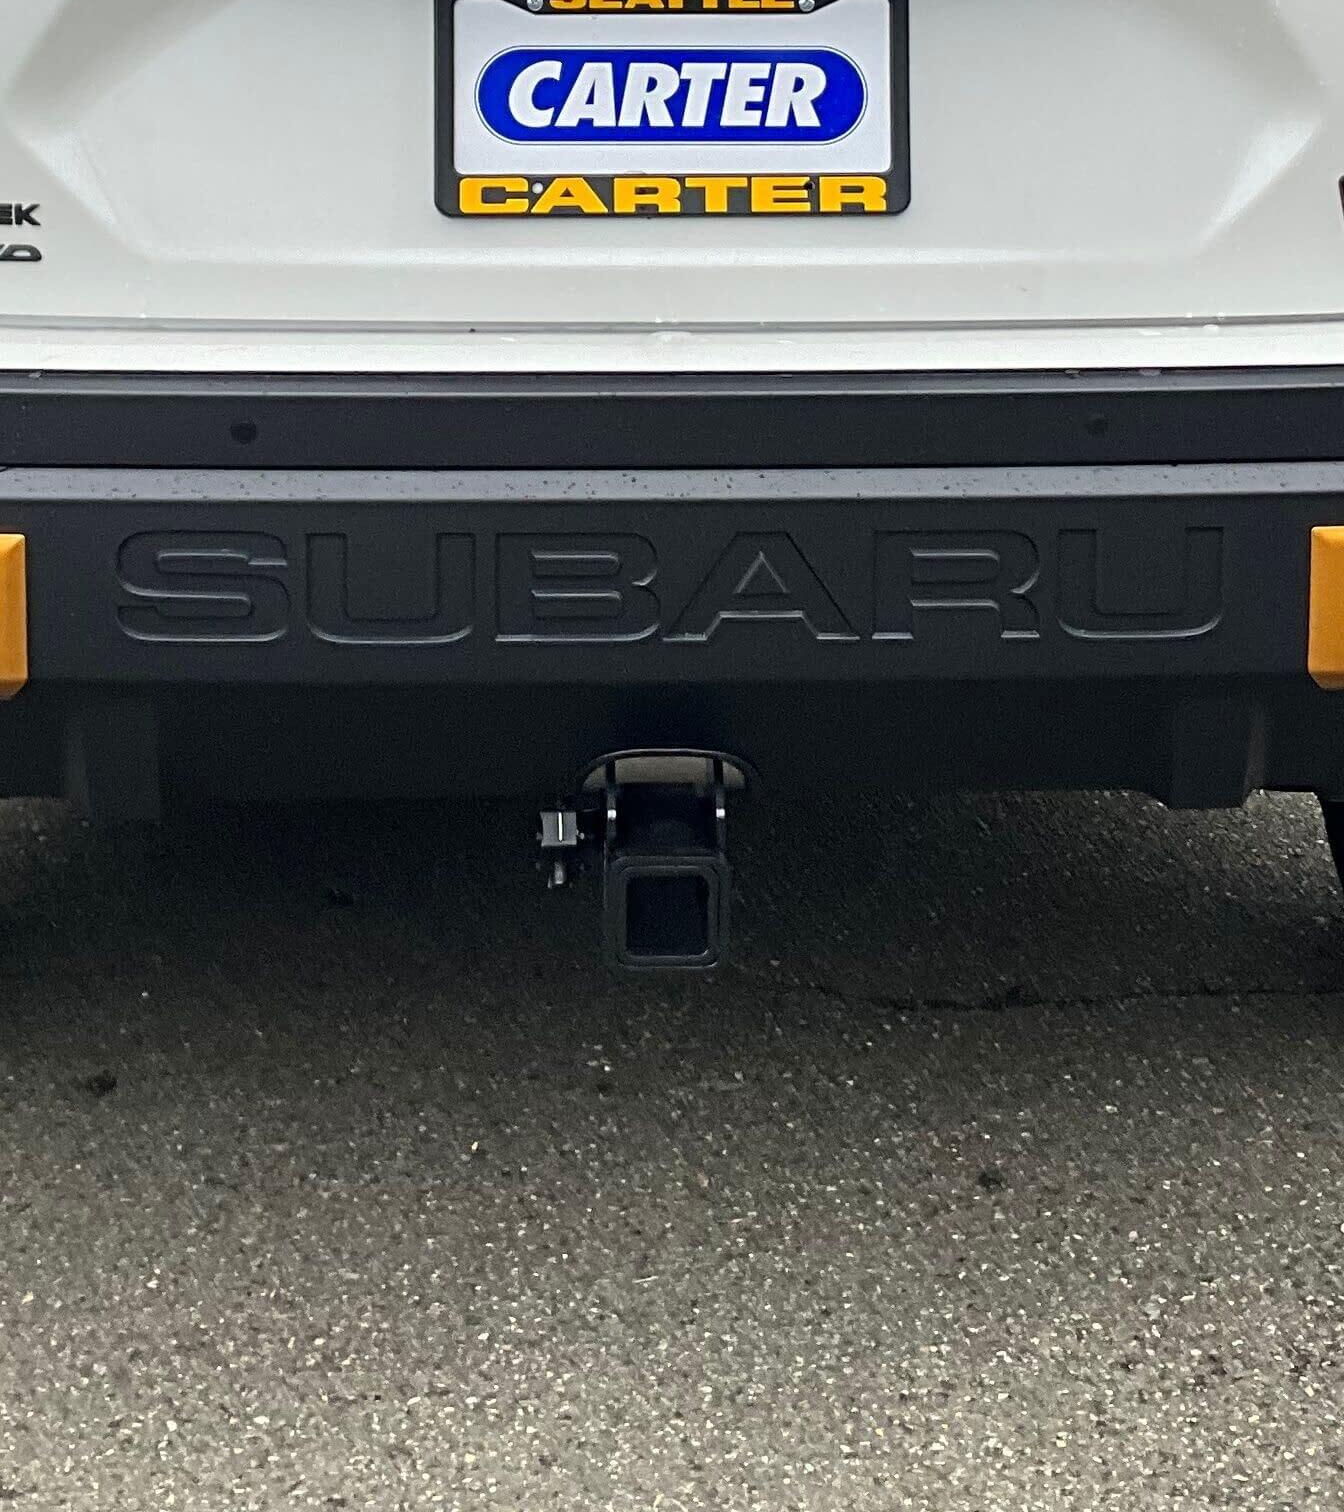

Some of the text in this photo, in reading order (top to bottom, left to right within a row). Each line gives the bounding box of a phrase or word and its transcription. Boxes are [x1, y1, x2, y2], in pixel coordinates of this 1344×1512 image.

[507, 60, 828, 128] CARTER
[459, 177, 888, 214] CARTER
[115, 527, 1227, 644] SUBARU
